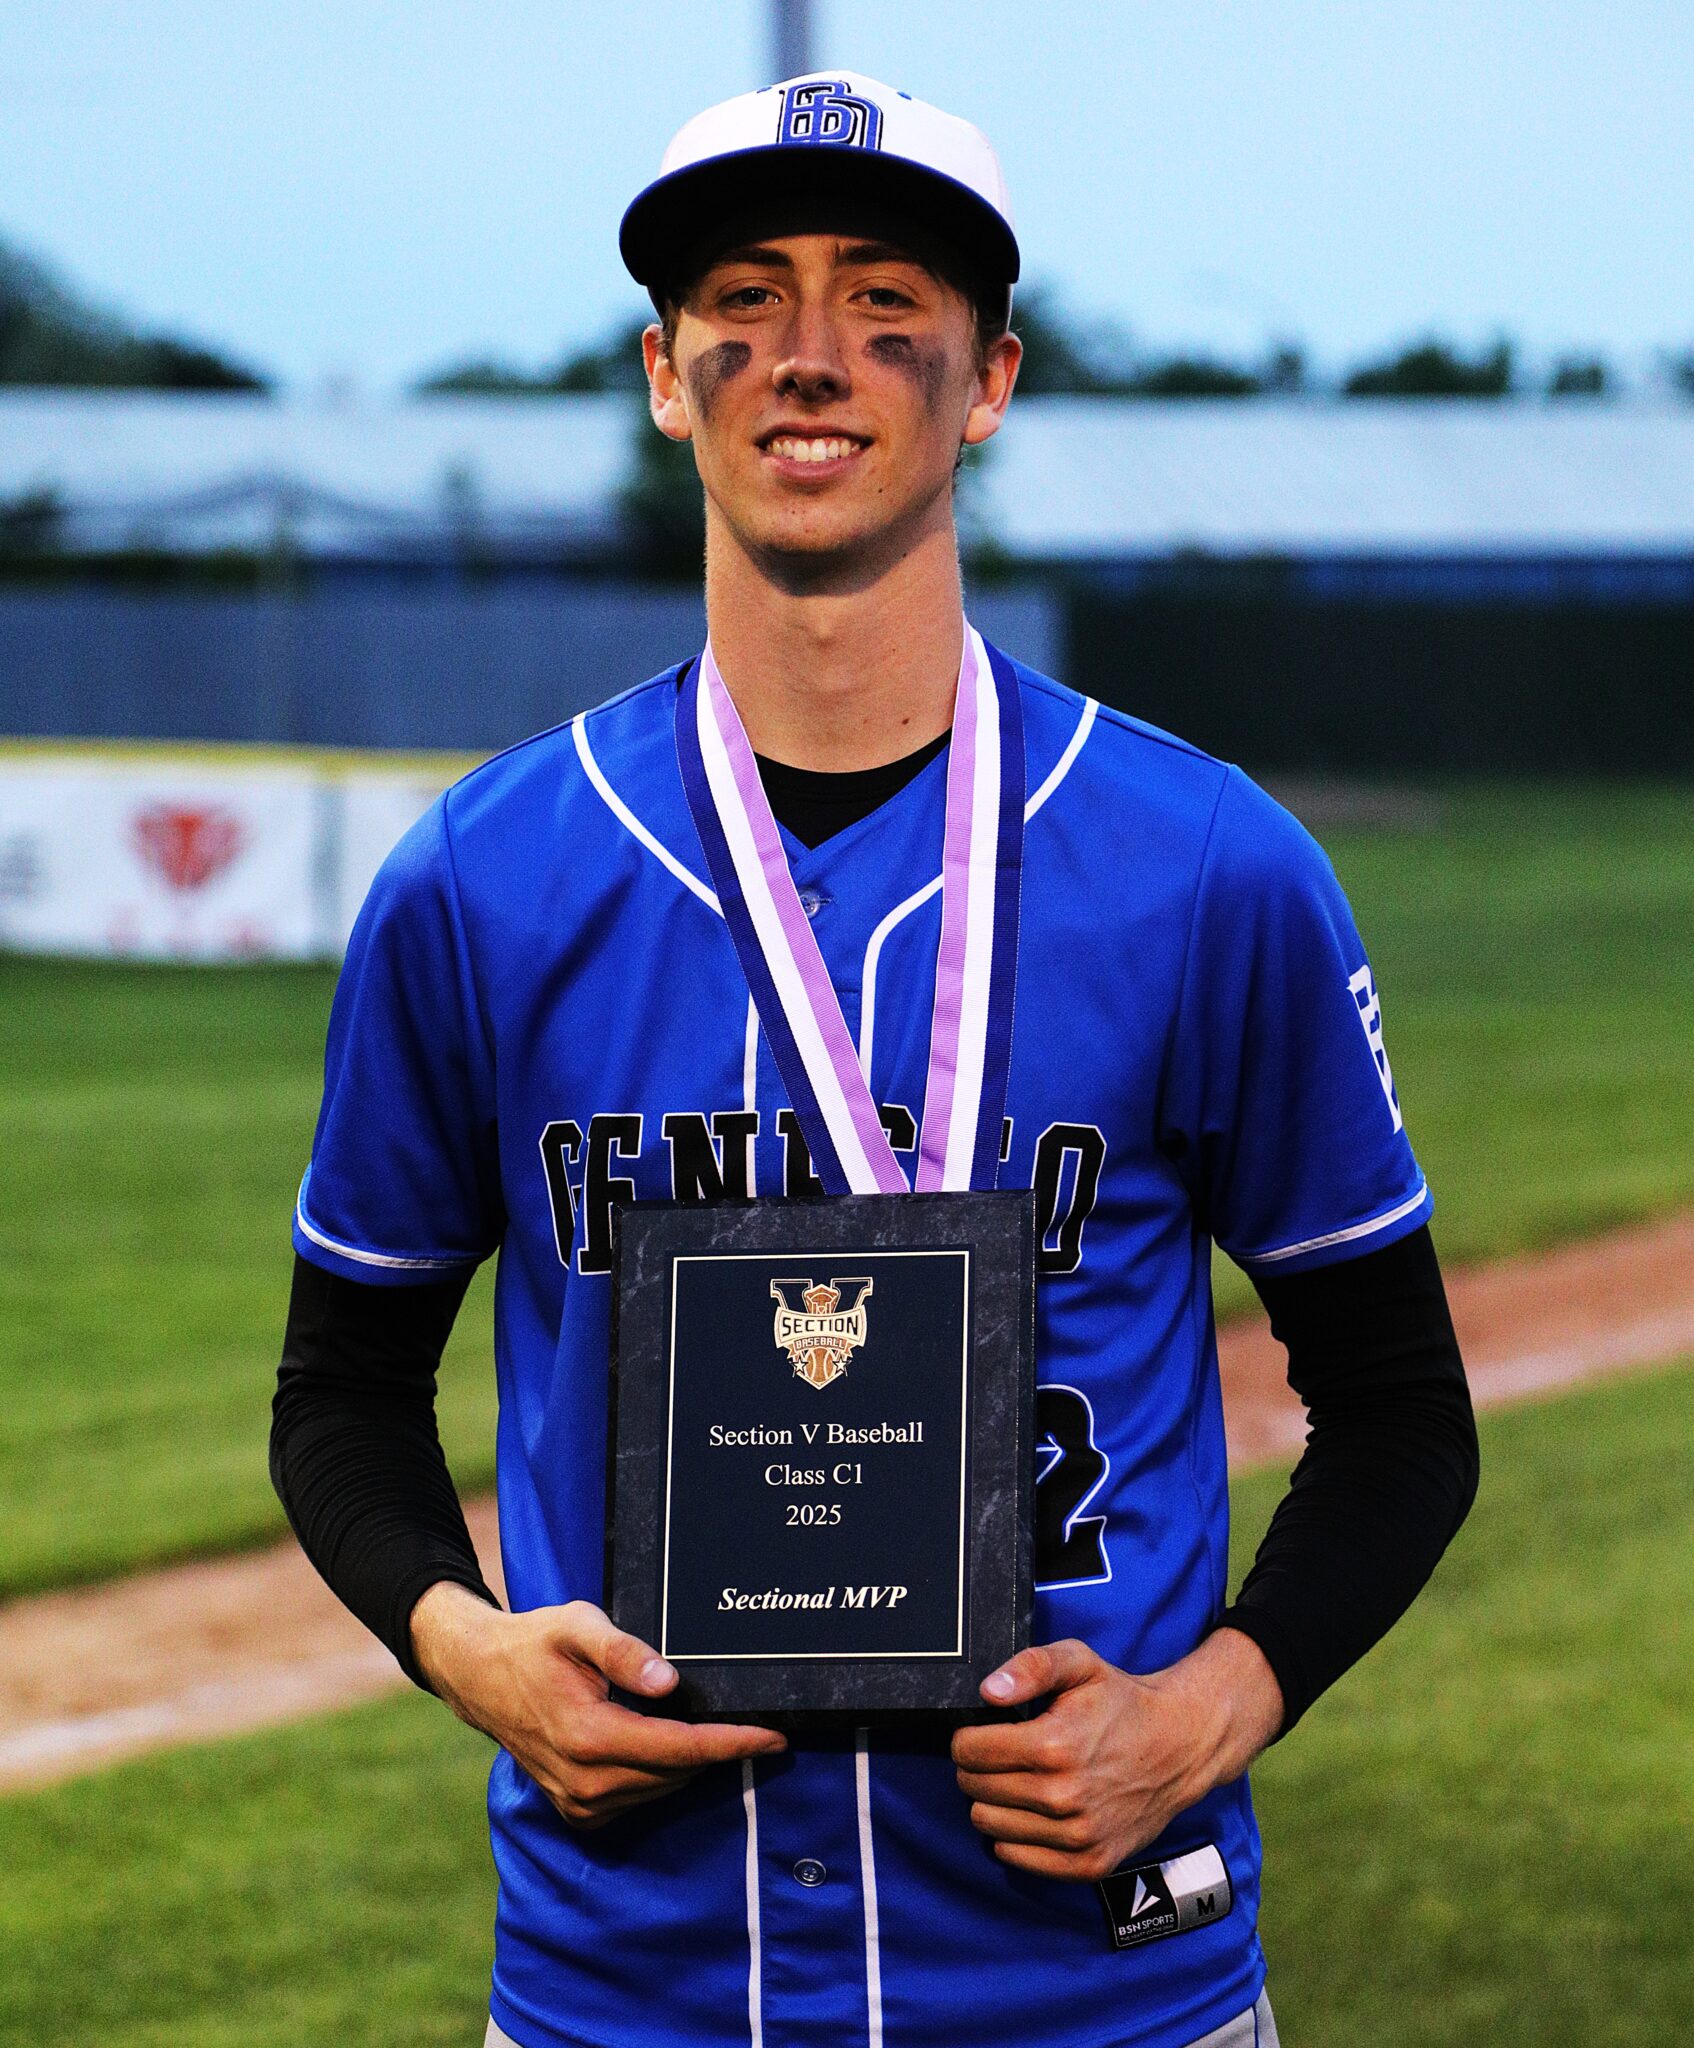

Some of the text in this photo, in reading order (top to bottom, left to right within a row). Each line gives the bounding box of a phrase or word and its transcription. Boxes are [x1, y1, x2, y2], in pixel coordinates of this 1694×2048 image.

[538, 1104, 1107, 1275] GENO
[782, 1315, 858, 1337] SECTION
[796, 1337, 845, 1349] BASEBALL
[709, 1422, 924, 1447] Section V Baseball
[764, 1463, 863, 1486] Class C1
[785, 1504, 842, 1526] 2025
[717, 1586, 908, 1611] Sectional MVP
[1196, 1893, 1215, 1917] M
[1118, 1922, 1141, 1936] BSN
[1141, 1913, 1175, 1930] SPORTS
